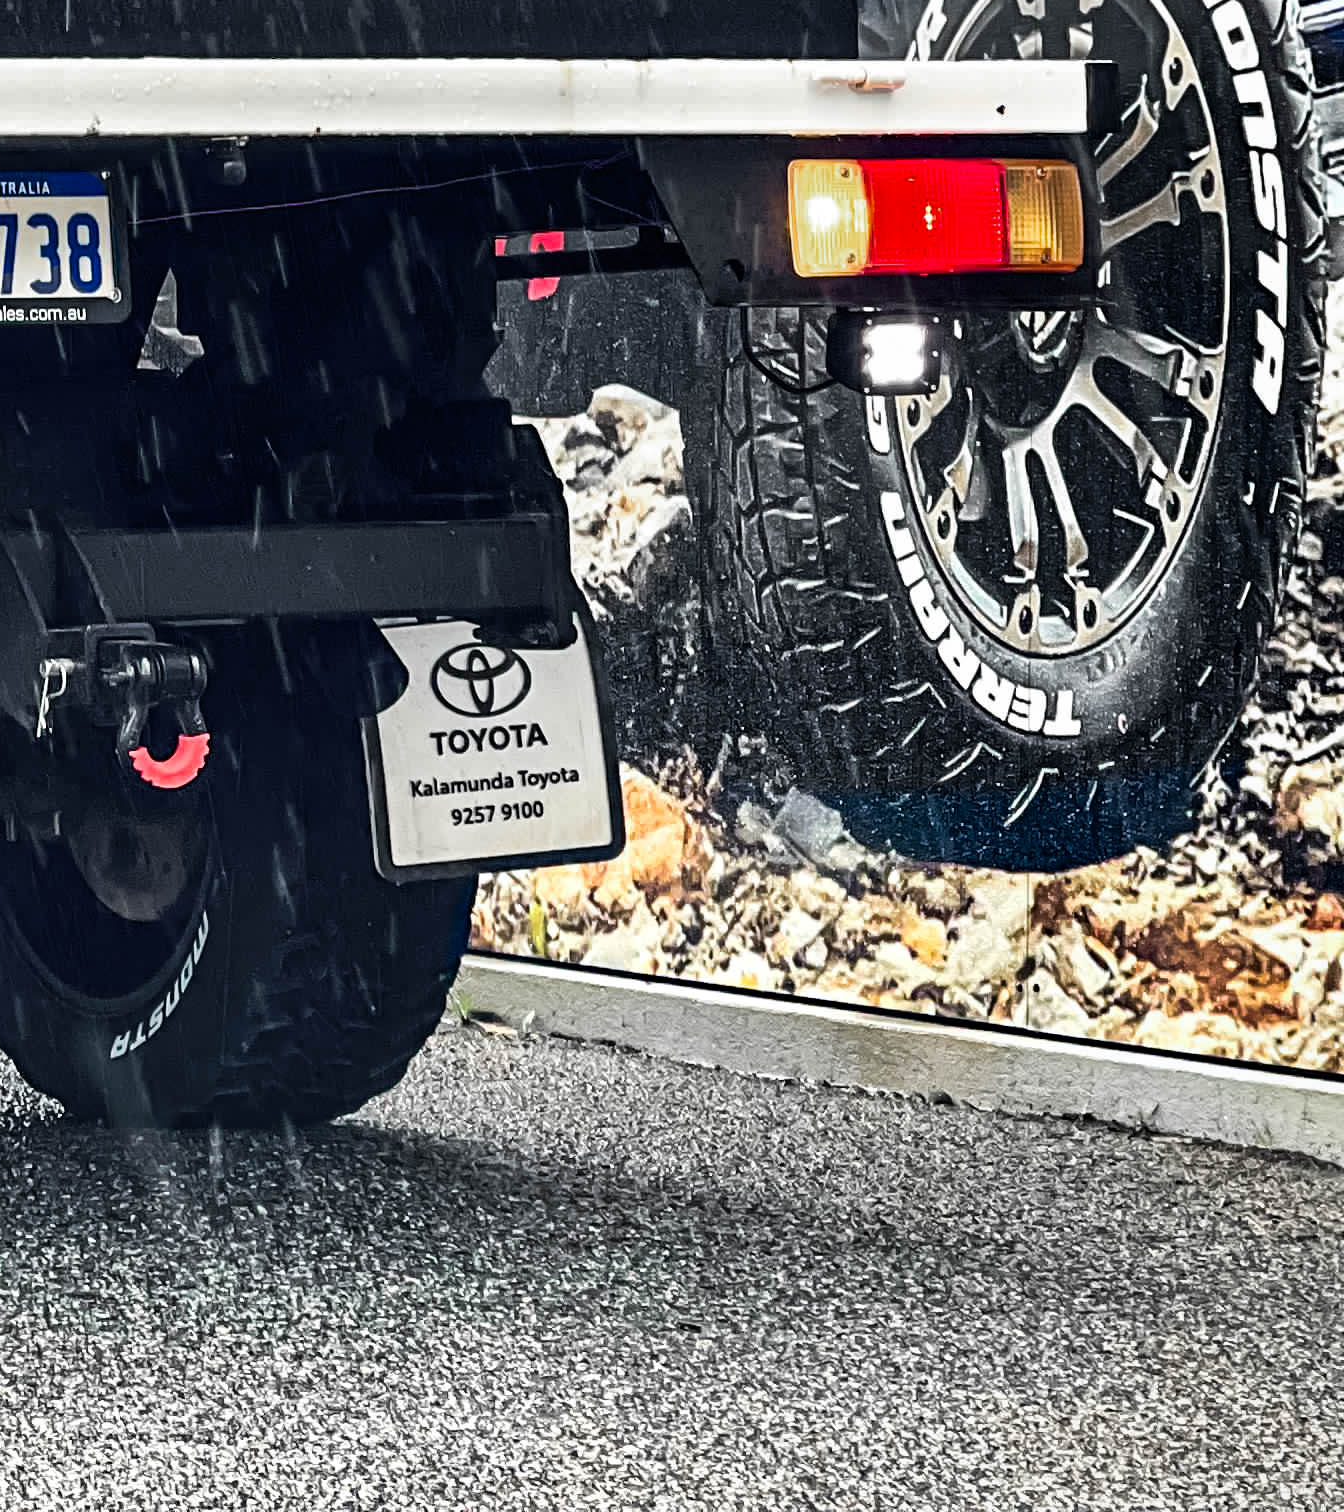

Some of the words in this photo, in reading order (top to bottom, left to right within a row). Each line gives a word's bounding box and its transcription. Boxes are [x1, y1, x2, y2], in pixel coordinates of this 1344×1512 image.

[880, 491, 1082, 737] TERRAIN
[430, 723, 548, 756] TOYOTA
[410, 772, 514, 799] Kalamunda
[517, 767, 580, 792] Toyota
[451, 804, 496, 826] 9257
[501, 800, 544, 821] 9100
[109, 909, 210, 1060] MONSTA
